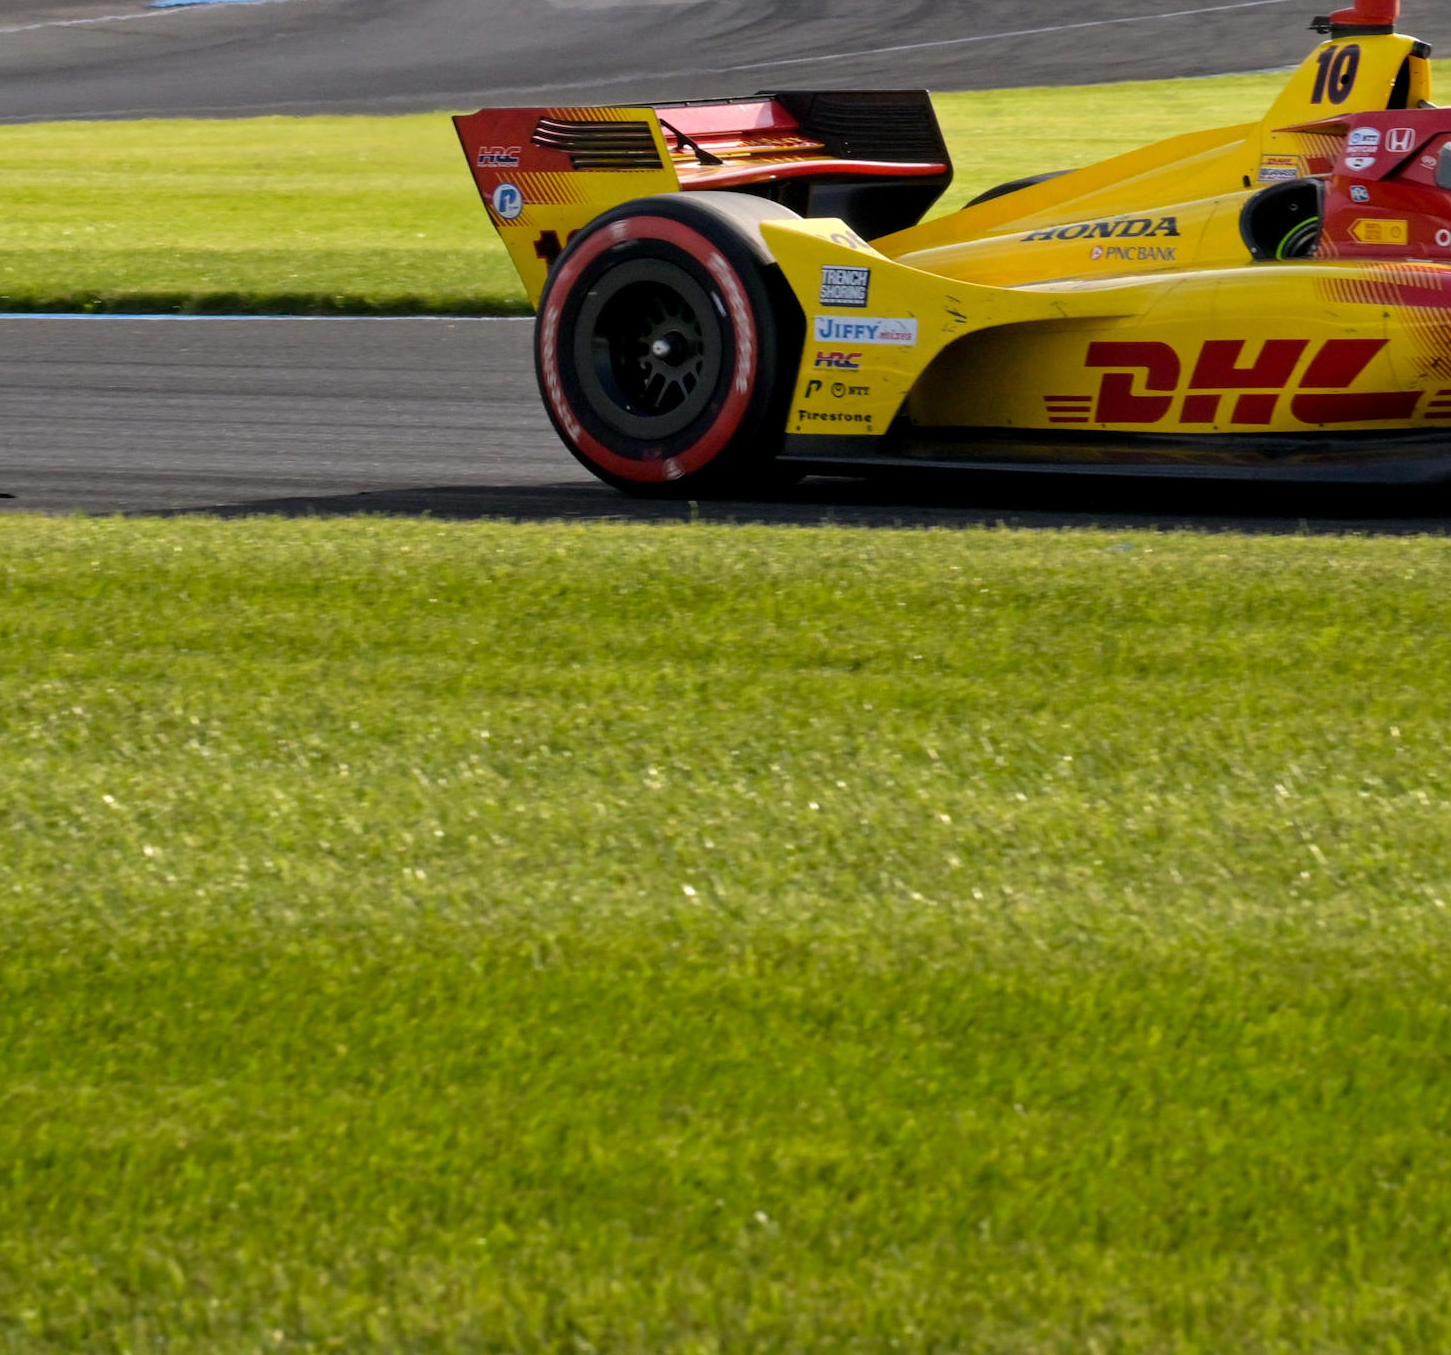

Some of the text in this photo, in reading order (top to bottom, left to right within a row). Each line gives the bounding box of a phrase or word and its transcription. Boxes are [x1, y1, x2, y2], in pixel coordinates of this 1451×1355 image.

[1310, 43, 1360, 105] 10
[1020, 216, 1181, 242] HONDA
[821, 269, 868, 286] TRENCH
[820, 284, 867, 300] SHORING
[814, 350, 863, 369] HRC
[1084, 338, 1425, 424] DHL
[797, 409, 873, 423] Firestone
